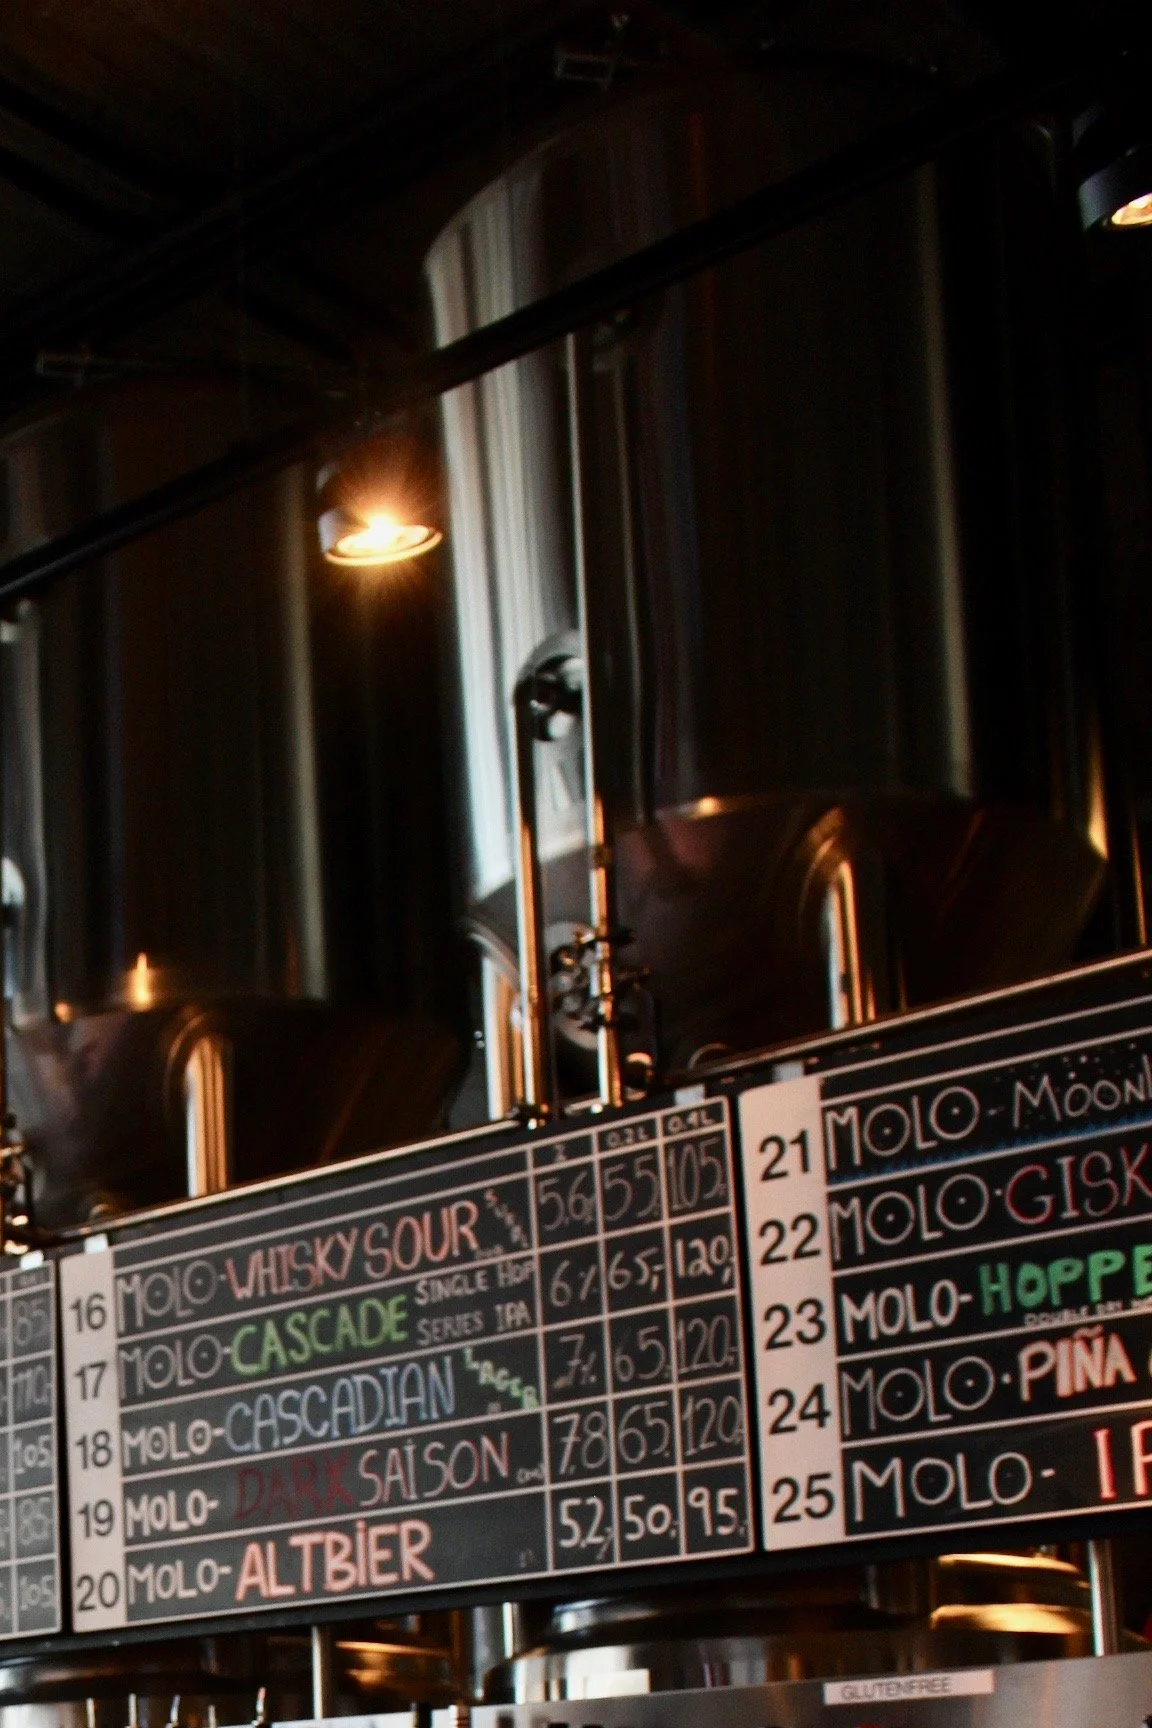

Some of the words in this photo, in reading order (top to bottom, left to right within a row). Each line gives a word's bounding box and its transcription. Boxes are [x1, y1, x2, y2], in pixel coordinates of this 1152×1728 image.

[759, 1129, 810, 1181] 21
[363, 1201, 479, 1279] SOUR
[758, 1212, 821, 1266] 22
[70, 1293, 107, 1333] 16
[415, 1269, 490, 1305] SINGLE
[230, 1293, 409, 1377] CASCADE
[417, 1310, 485, 1346] SERIES
[496, 1300, 532, 1332] IPA
[764, 1299, 826, 1351] 23
[74, 1362, 107, 1401] 17
[1018, 1325, 1138, 1401] PIÑA
[224, 1355, 456, 1451] CASCADIAN
[768, 1384, 830, 1436] 24
[76, 1431, 112, 1470] 18
[233, 1450, 354, 1521] DARK
[359, 1431, 510, 1507] SAISON
[78, 1500, 114, 1538] 19
[773, 1473, 834, 1524] 25
[234, 1519, 436, 1601] ALTBIER
[77, 1572, 119, 1612] 20
[840, 1678, 950, 1701] GLUTENFREE
